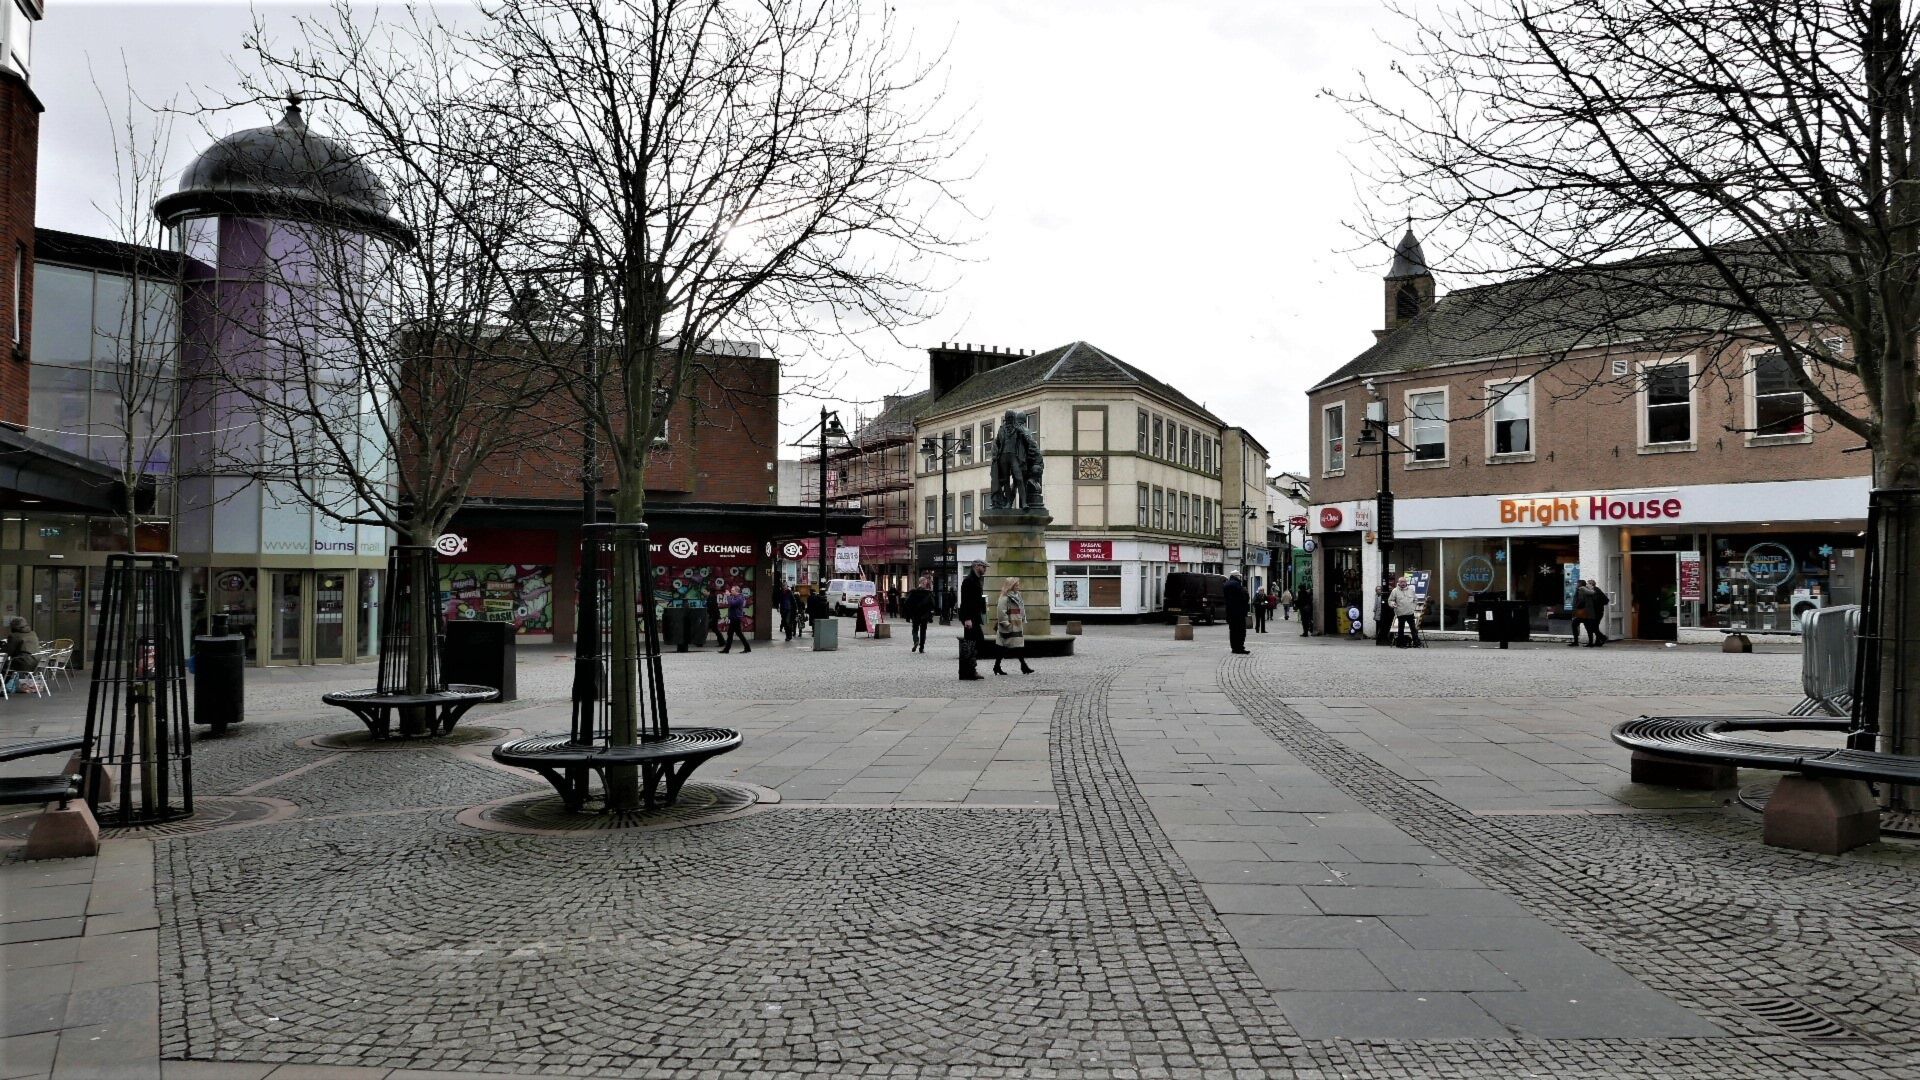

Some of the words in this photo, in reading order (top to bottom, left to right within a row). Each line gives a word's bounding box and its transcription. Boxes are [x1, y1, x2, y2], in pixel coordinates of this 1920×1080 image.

[1500, 497, 1580, 526] Bright
[1589, 496, 1682, 520] House
[314, 540, 355, 551] burns
[703, 544, 752, 554] EXCHANGE
[1750, 562, 1788, 573] SALE
[1462, 573, 1489, 582] SALE
[489, 611, 513, 622] CASH
